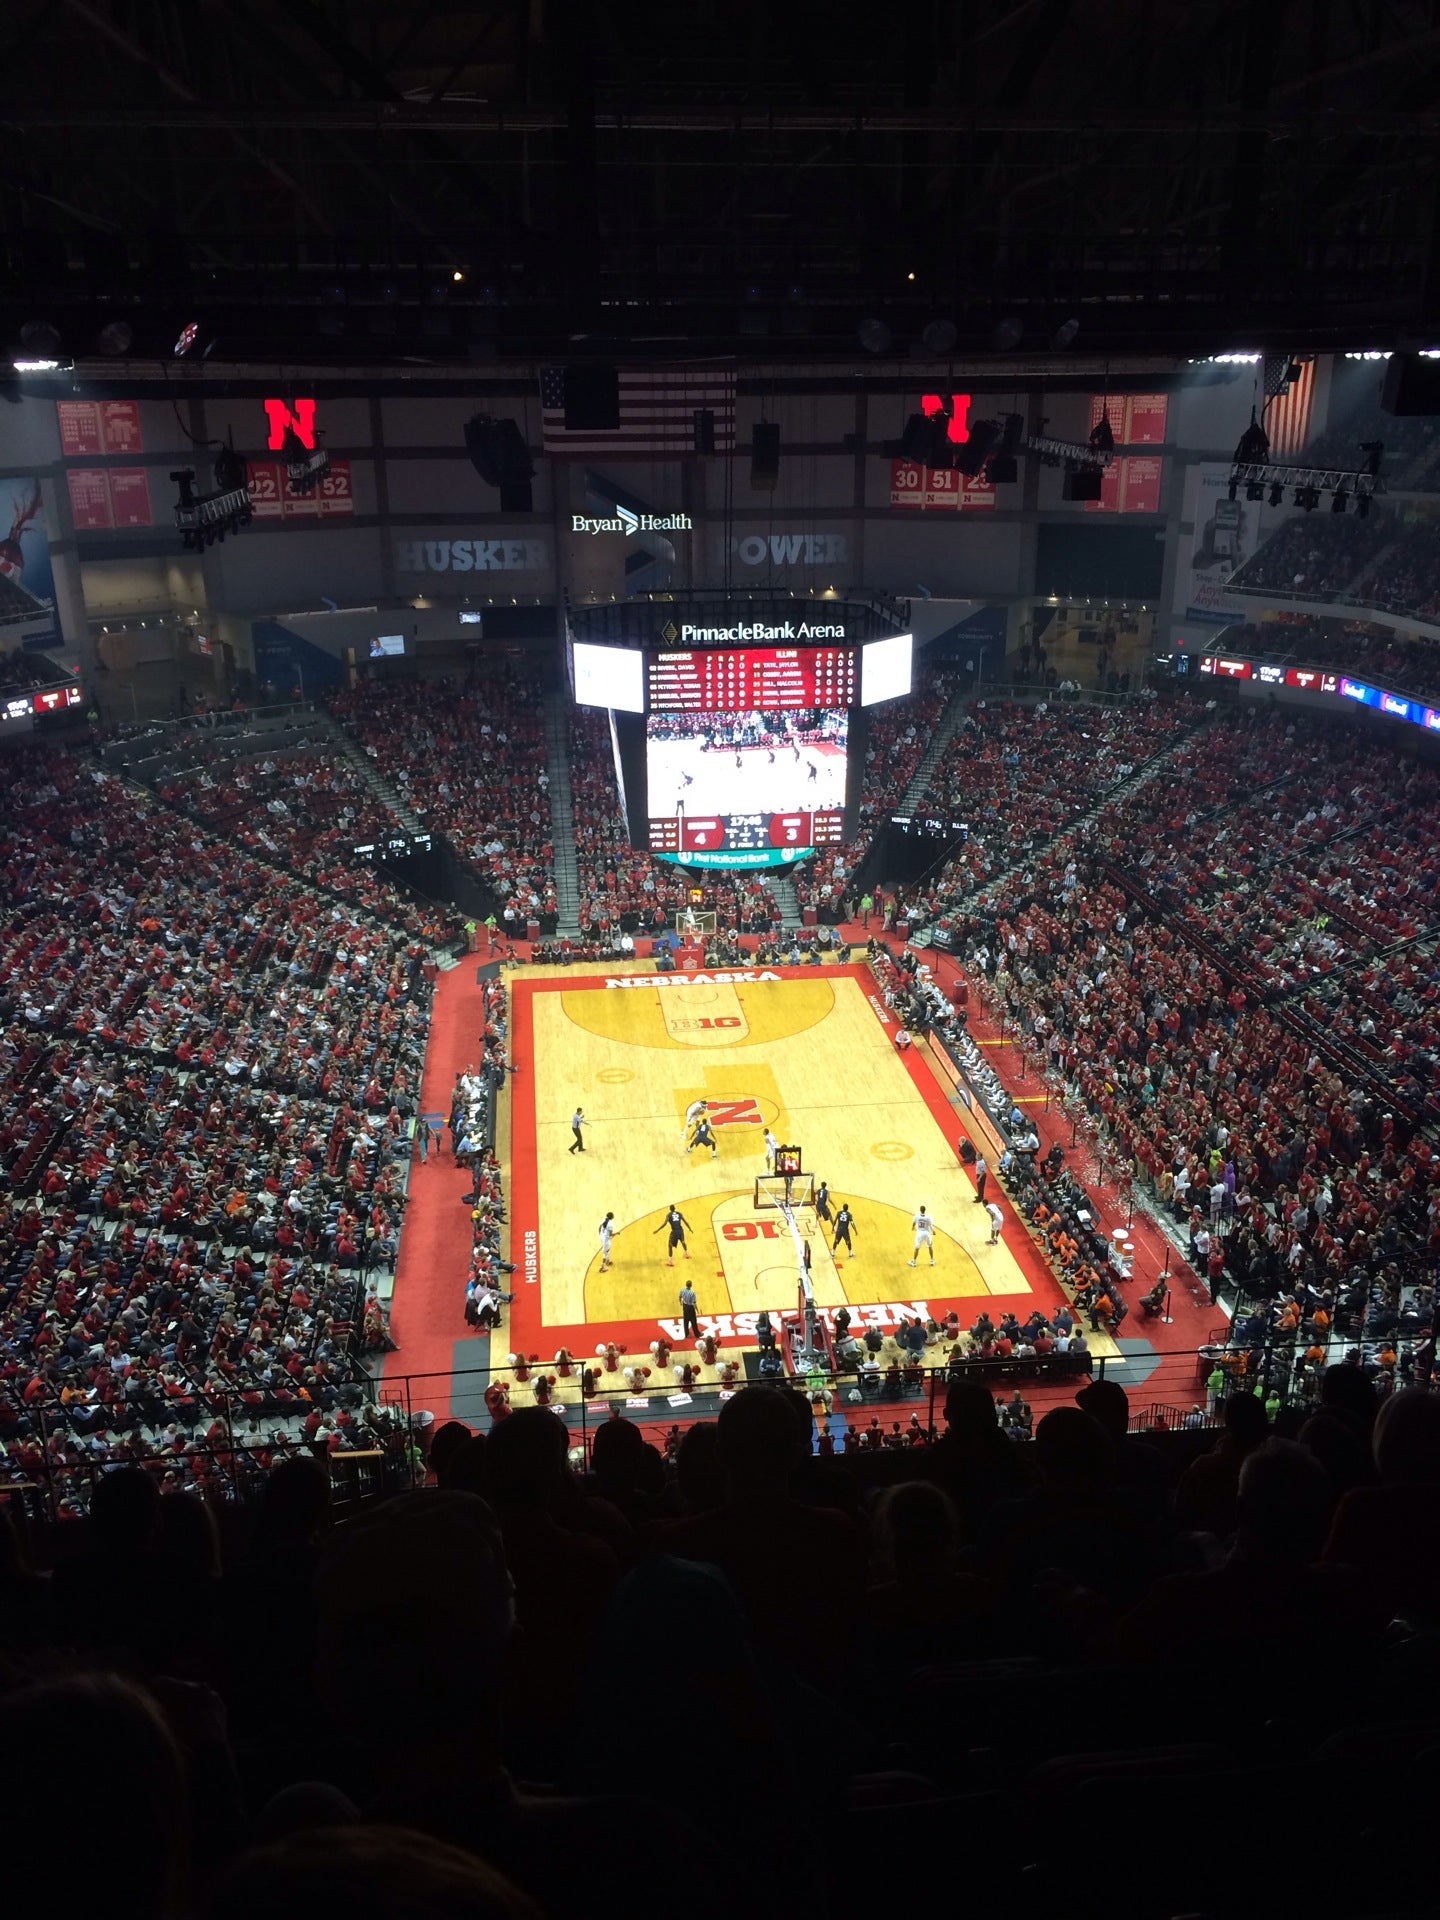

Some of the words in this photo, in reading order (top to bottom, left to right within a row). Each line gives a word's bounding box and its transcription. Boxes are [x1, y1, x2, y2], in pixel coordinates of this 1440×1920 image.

[264, 398, 316, 450] N
[323, 477, 348, 496] 52
[896, 471, 918, 488] 30
[932, 471, 952, 489] 51
[248, 479, 276, 498] 22
[572, 516, 622, 534] Bryan
[640, 514, 692, 530] Health
[797, 622, 845, 638] Arena
[694, 832, 706, 844] 4
[786, 828, 797, 841] 3
[426, 842, 431, 851] 3
[711, 854, 746, 864] National
[605, 971, 782, 988] NEBRASKA
[866, 995, 890, 1023] HUSKERS
[706, 1098, 764, 1126] N
[840, 1213, 847, 1222] 25
[525, 1230, 537, 1283] HUSKERS
